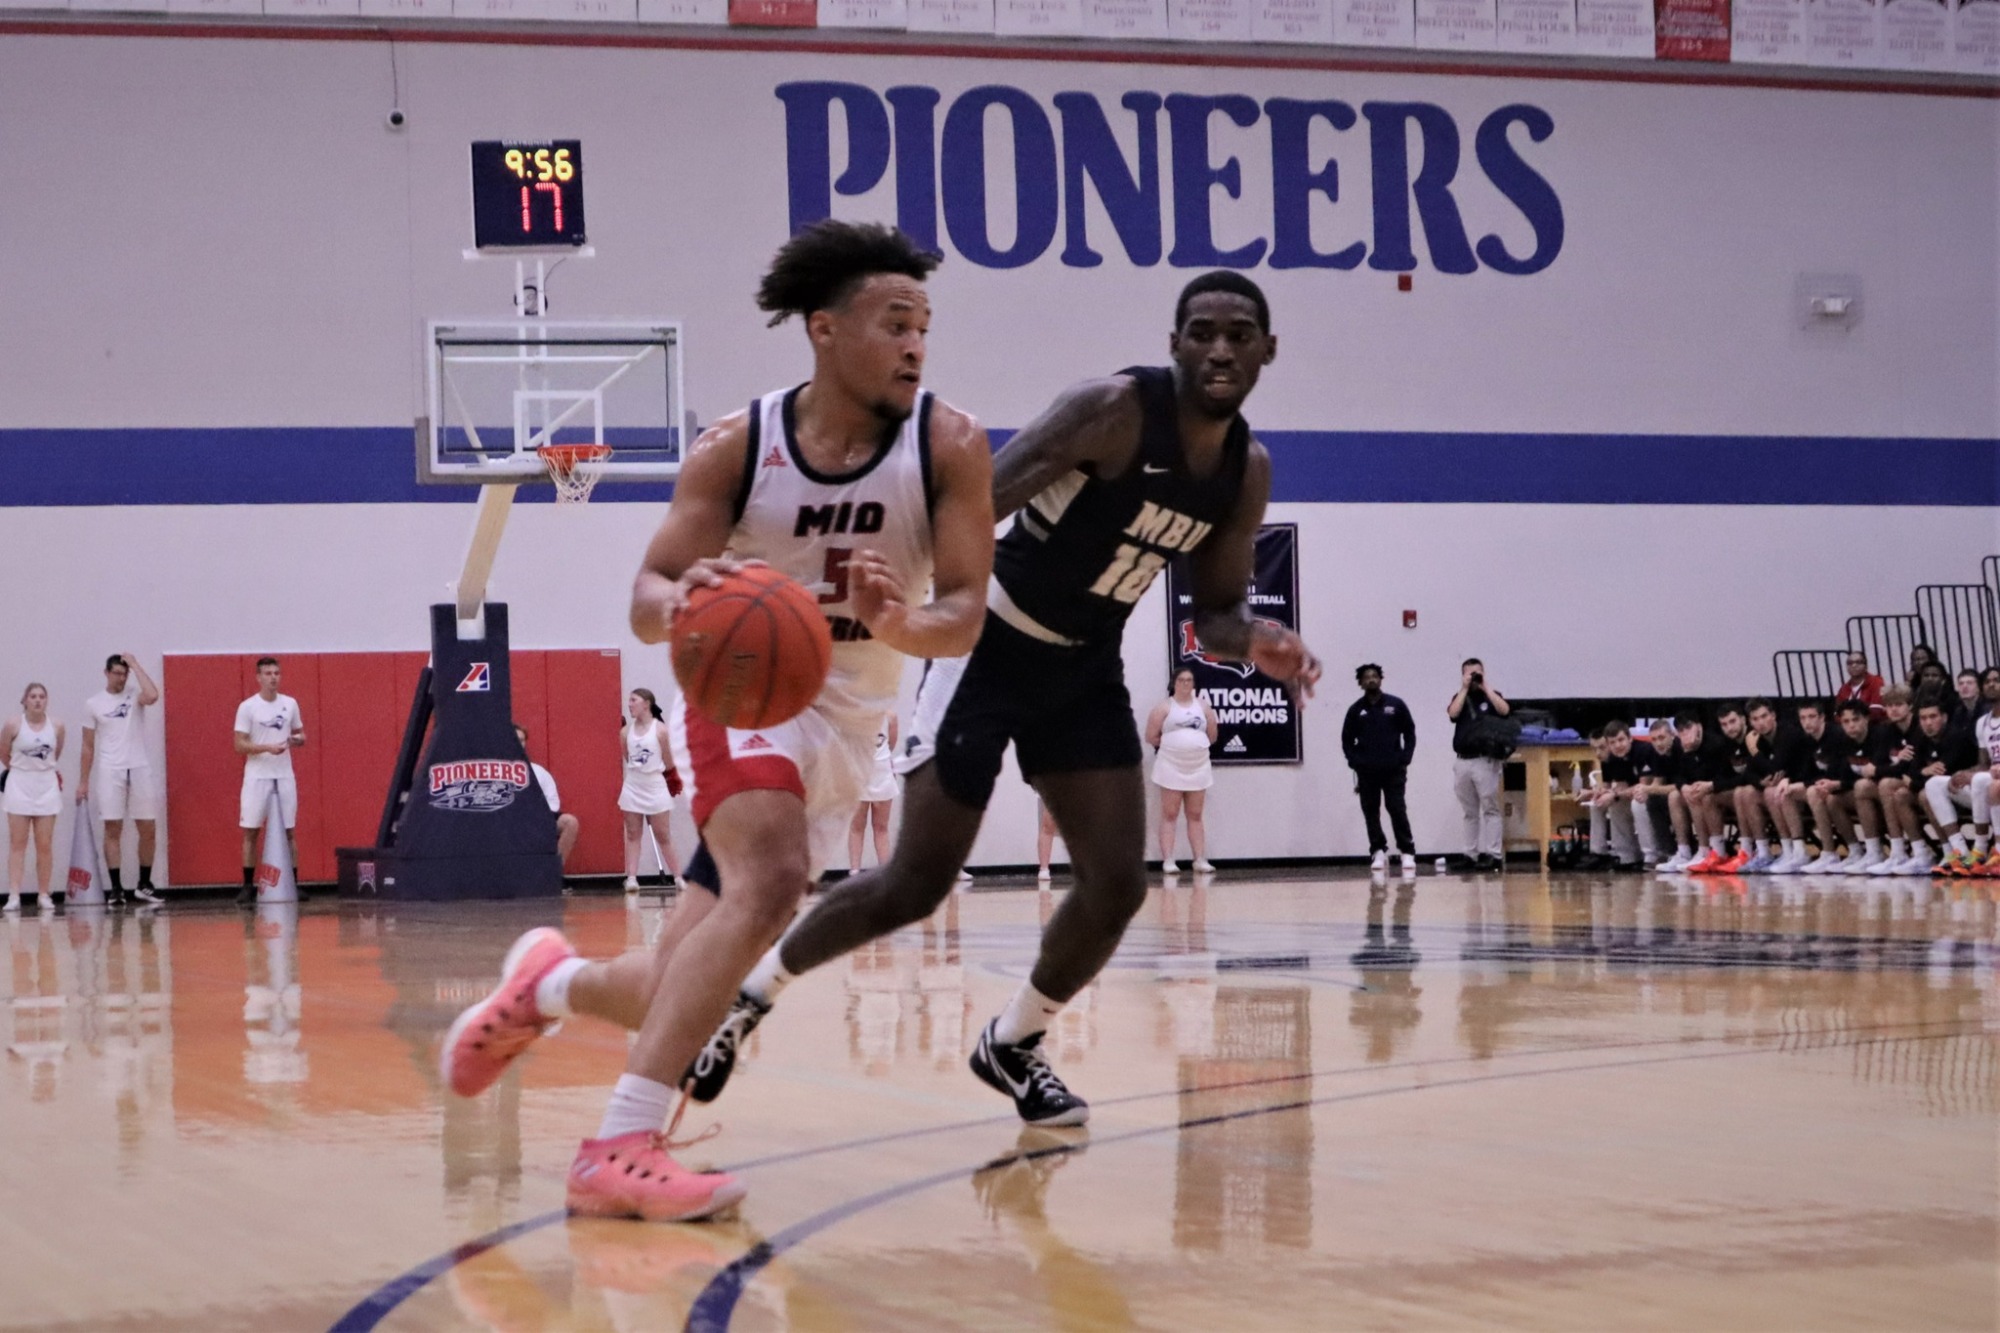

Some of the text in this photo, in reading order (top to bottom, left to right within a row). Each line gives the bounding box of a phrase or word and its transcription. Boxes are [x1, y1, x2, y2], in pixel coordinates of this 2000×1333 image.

[504, 148, 573, 182] 9:56
[774, 81, 1564, 275] PIONEERS
[520, 182, 564, 233] 17
[793, 501, 885, 538] MID
[1211, 708, 1288, 724] AMPIONS
[430, 761, 529, 793] PIONEERS
